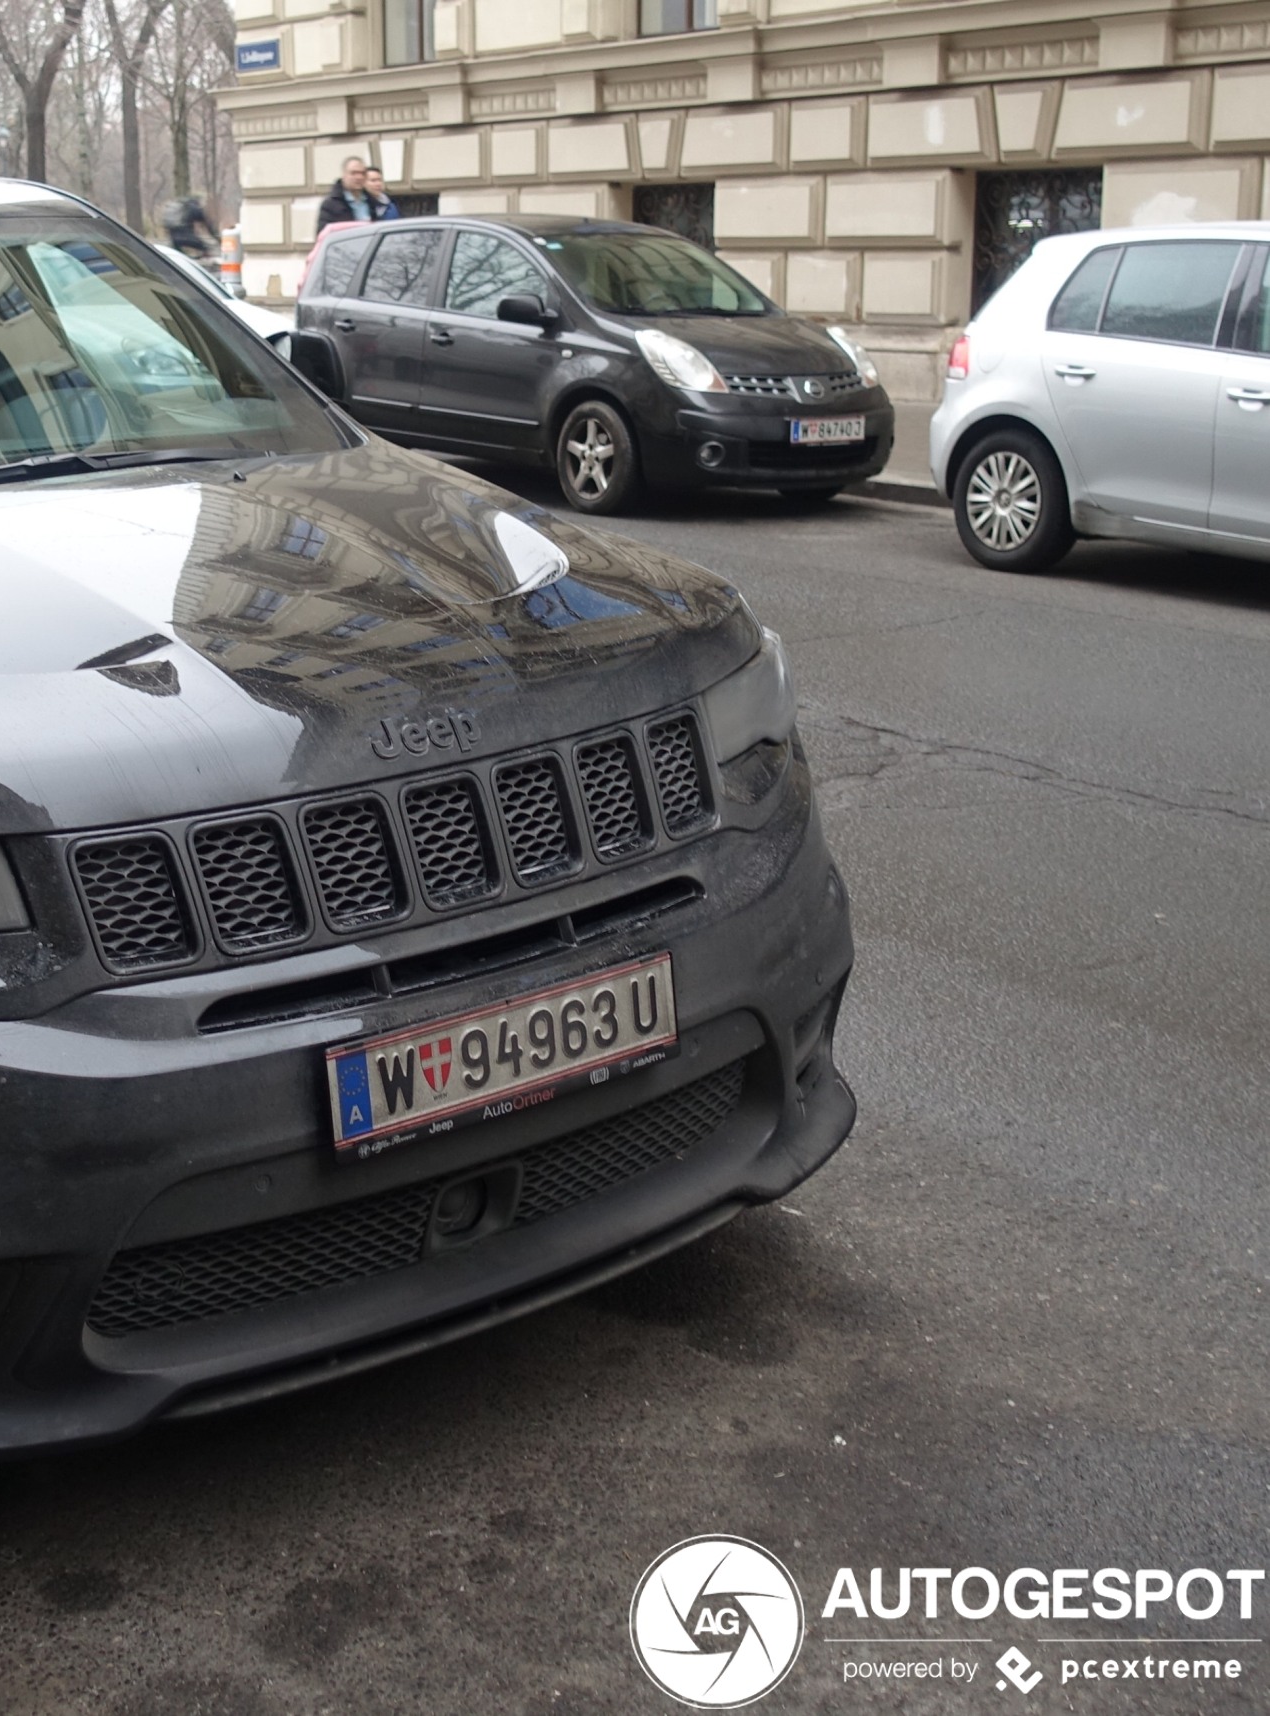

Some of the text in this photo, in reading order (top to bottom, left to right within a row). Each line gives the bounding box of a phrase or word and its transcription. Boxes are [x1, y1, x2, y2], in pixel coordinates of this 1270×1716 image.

[370, 711, 481, 760] Jeep
[375, 972, 658, 1116] W 94963 U
[349, 1105, 364, 1125] A
[428, 1119, 454, 1135] Jeep
